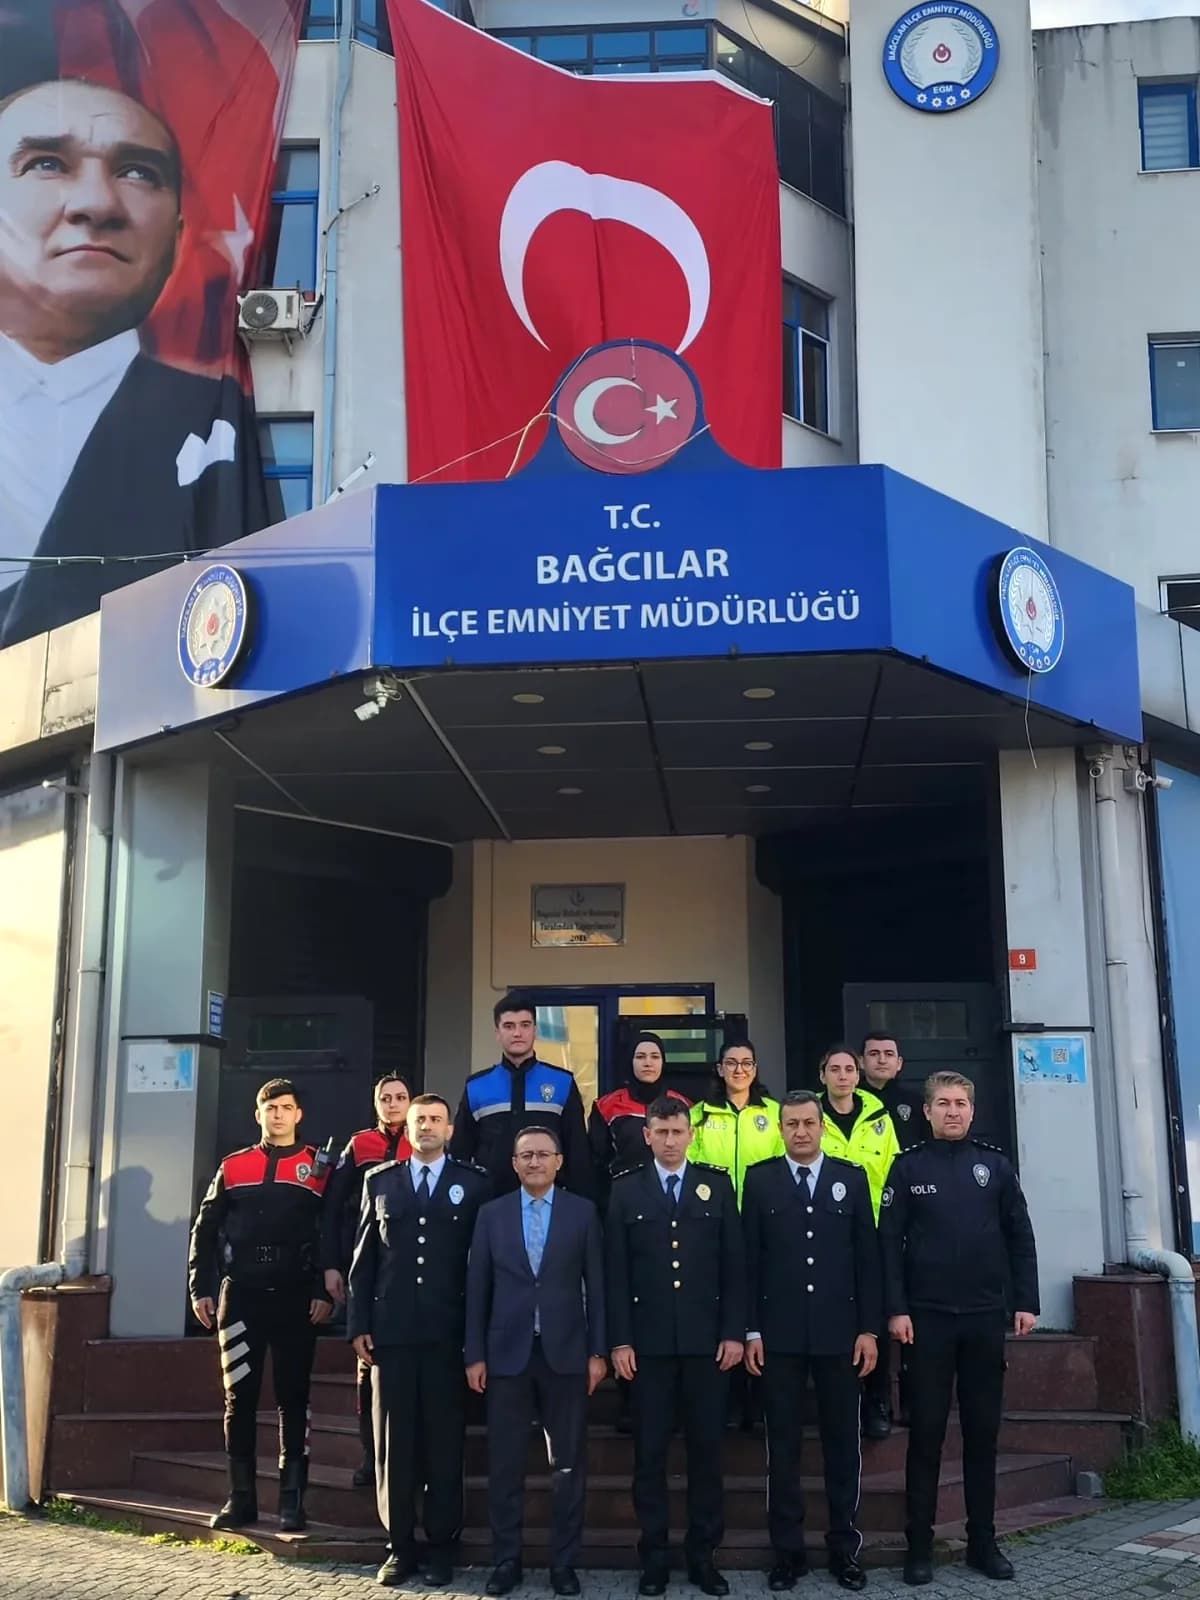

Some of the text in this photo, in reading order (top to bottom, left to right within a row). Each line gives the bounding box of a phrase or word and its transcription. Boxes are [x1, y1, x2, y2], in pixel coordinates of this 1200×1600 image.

[932, 85, 953, 94] EGM
[603, 503, 661, 530] T.C.
[536, 546, 730, 584] BAĞCILAR
[412, 588, 860, 643] İLÇE EMNİYET MÜDÜRLÜĞÜ
[1019, 953, 1026, 965] 9
